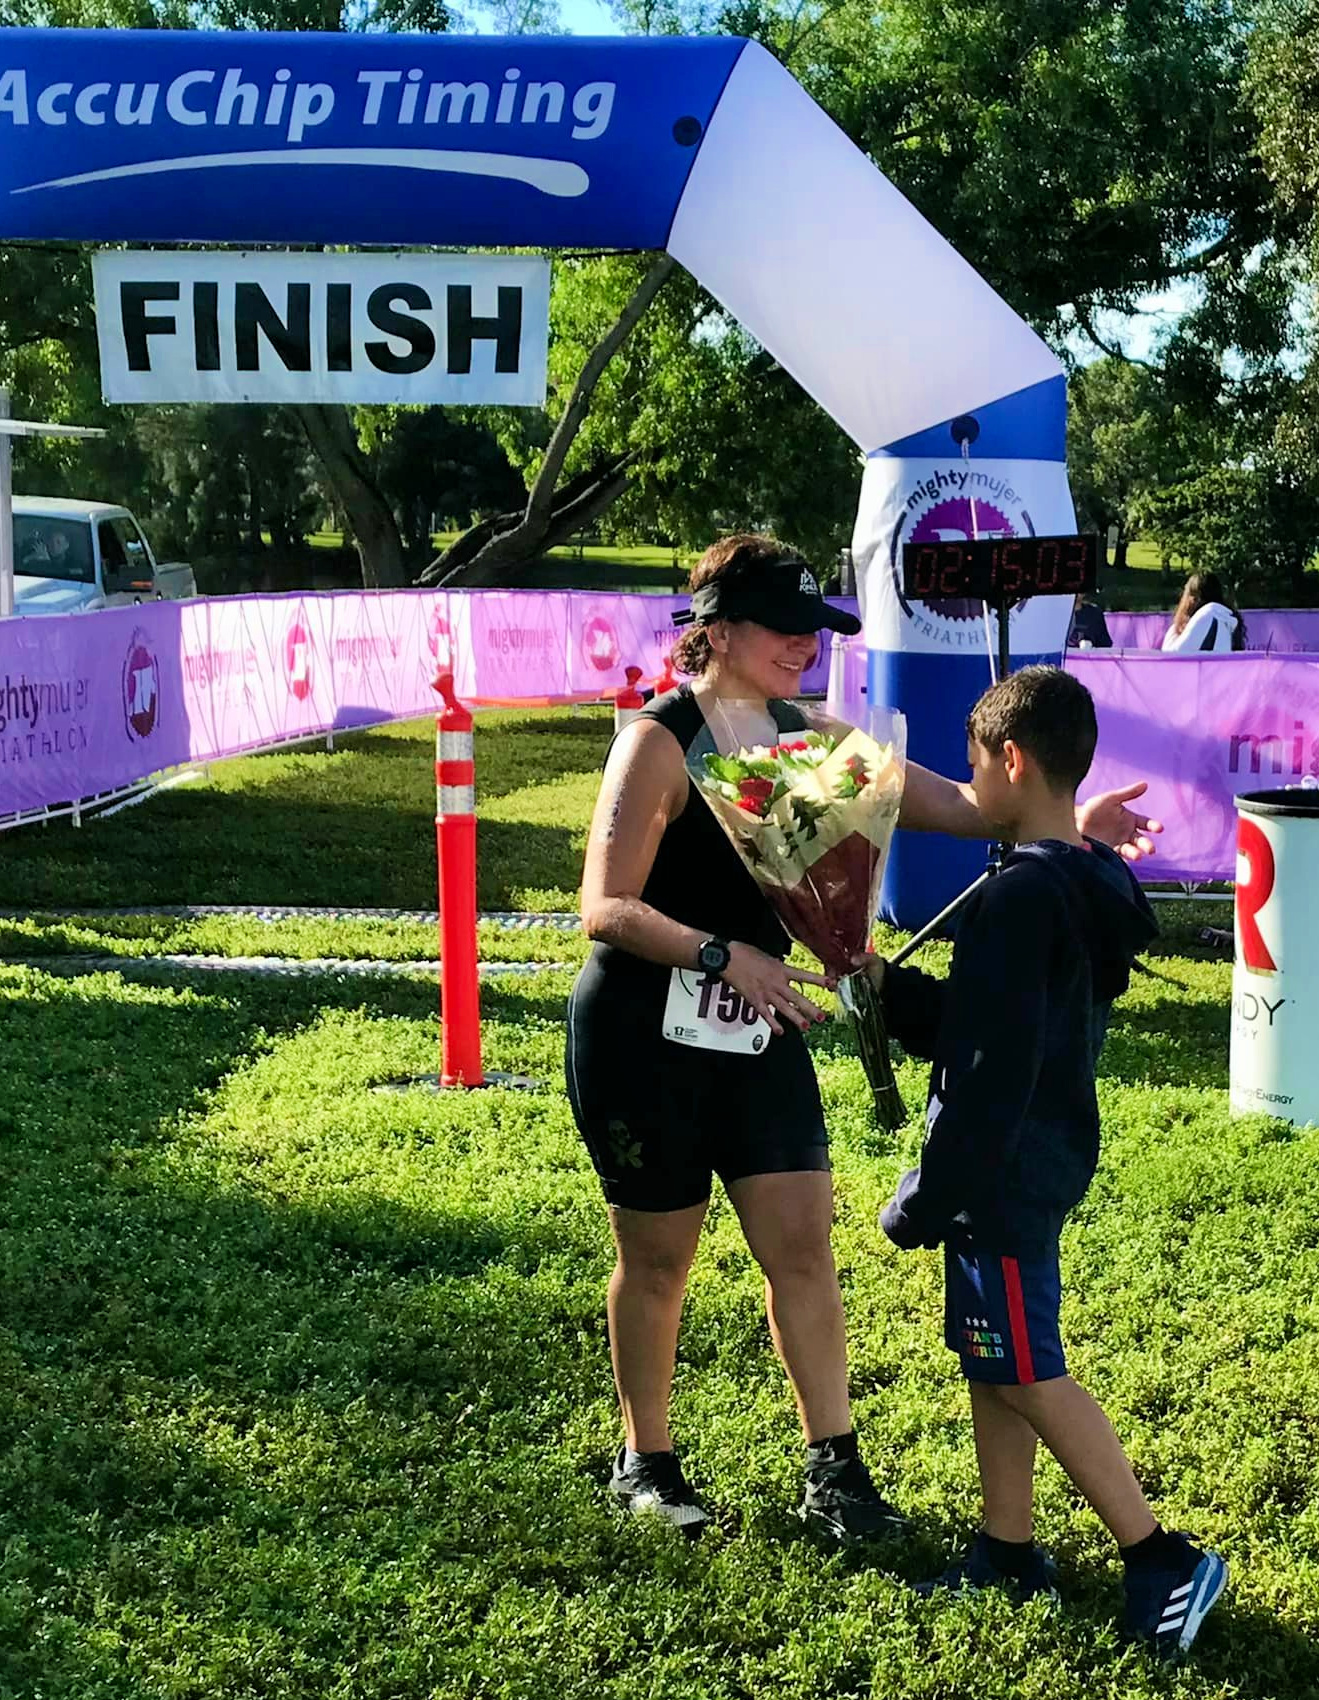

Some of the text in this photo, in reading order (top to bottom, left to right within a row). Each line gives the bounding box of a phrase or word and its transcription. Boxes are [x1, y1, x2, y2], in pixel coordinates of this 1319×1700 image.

[0, 69, 616, 141] AccuChip Timing
[119, 281, 523, 375] FINISH
[906, 469, 1022, 510] mightymujer
[911, 612, 1018, 646] TRIATHL
